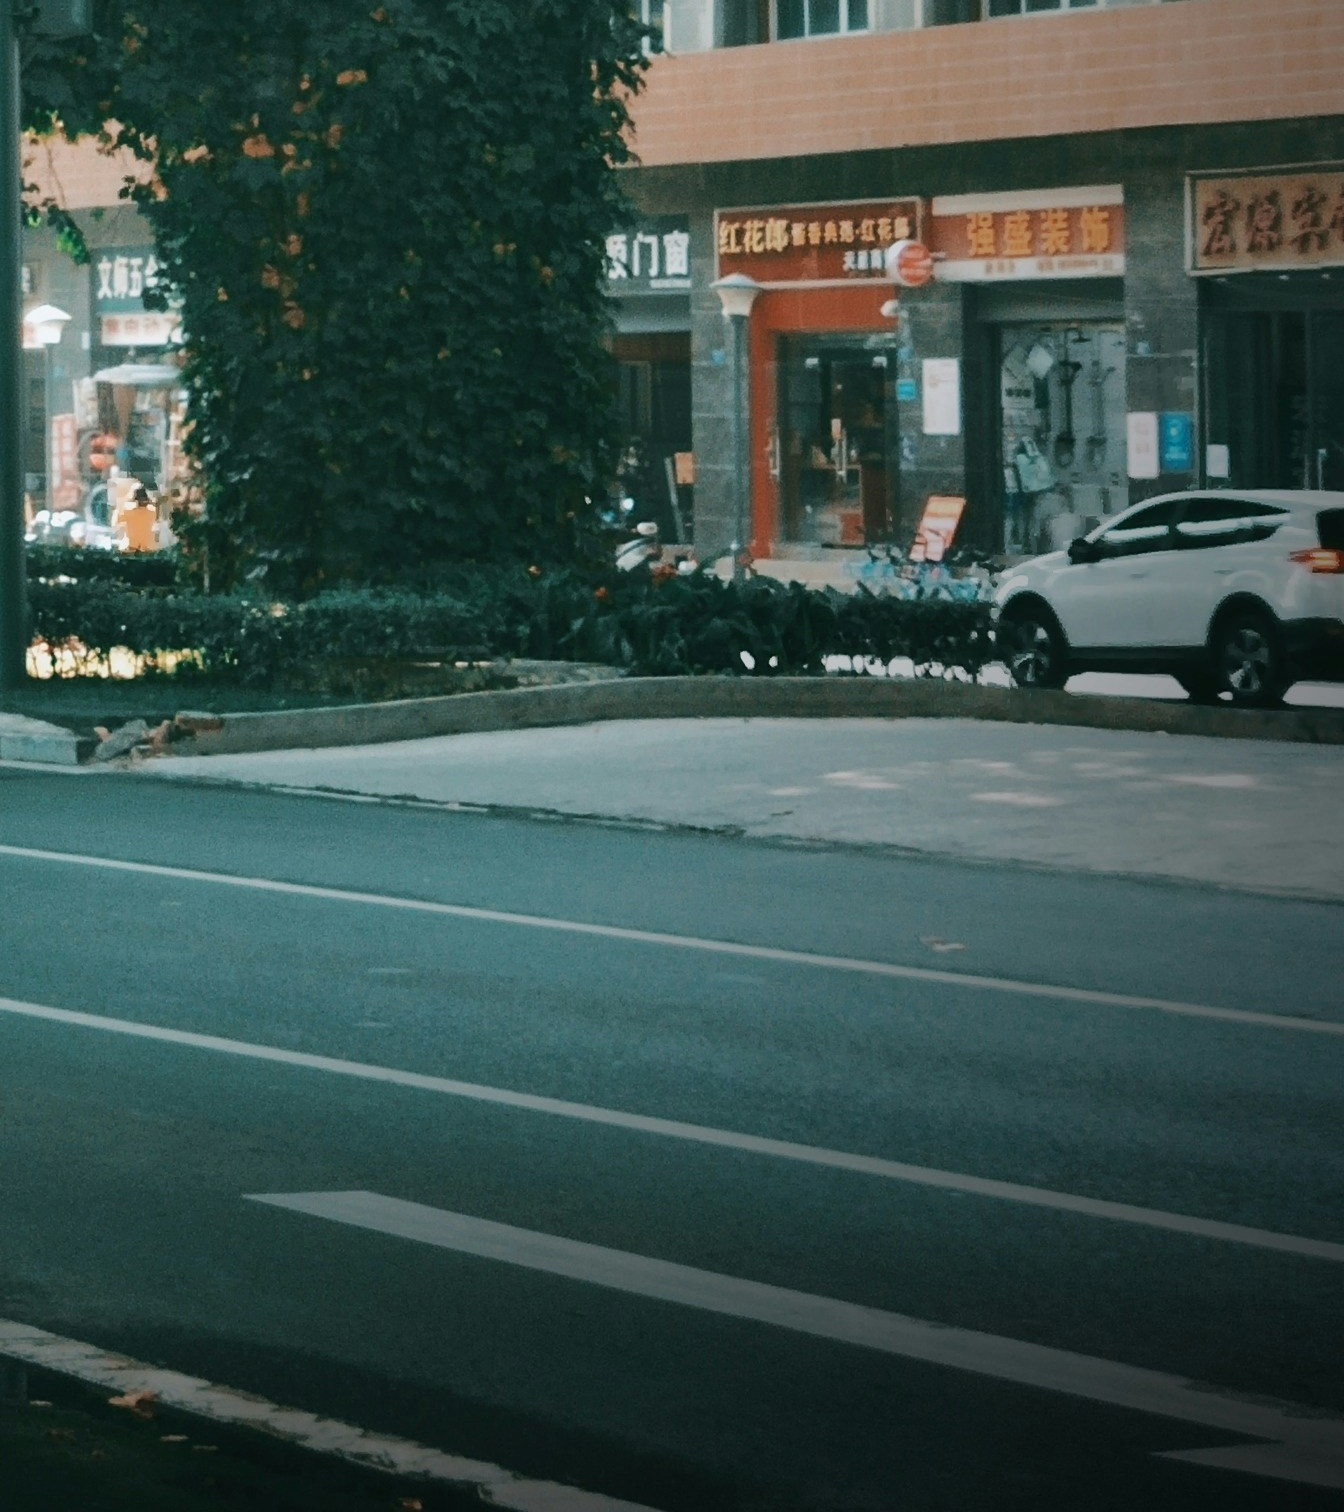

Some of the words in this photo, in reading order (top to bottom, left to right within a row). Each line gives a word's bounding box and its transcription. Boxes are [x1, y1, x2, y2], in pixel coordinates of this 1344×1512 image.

[720, 217, 790, 254] 红花郎
[967, 206, 1110, 256] 强盛装饰
